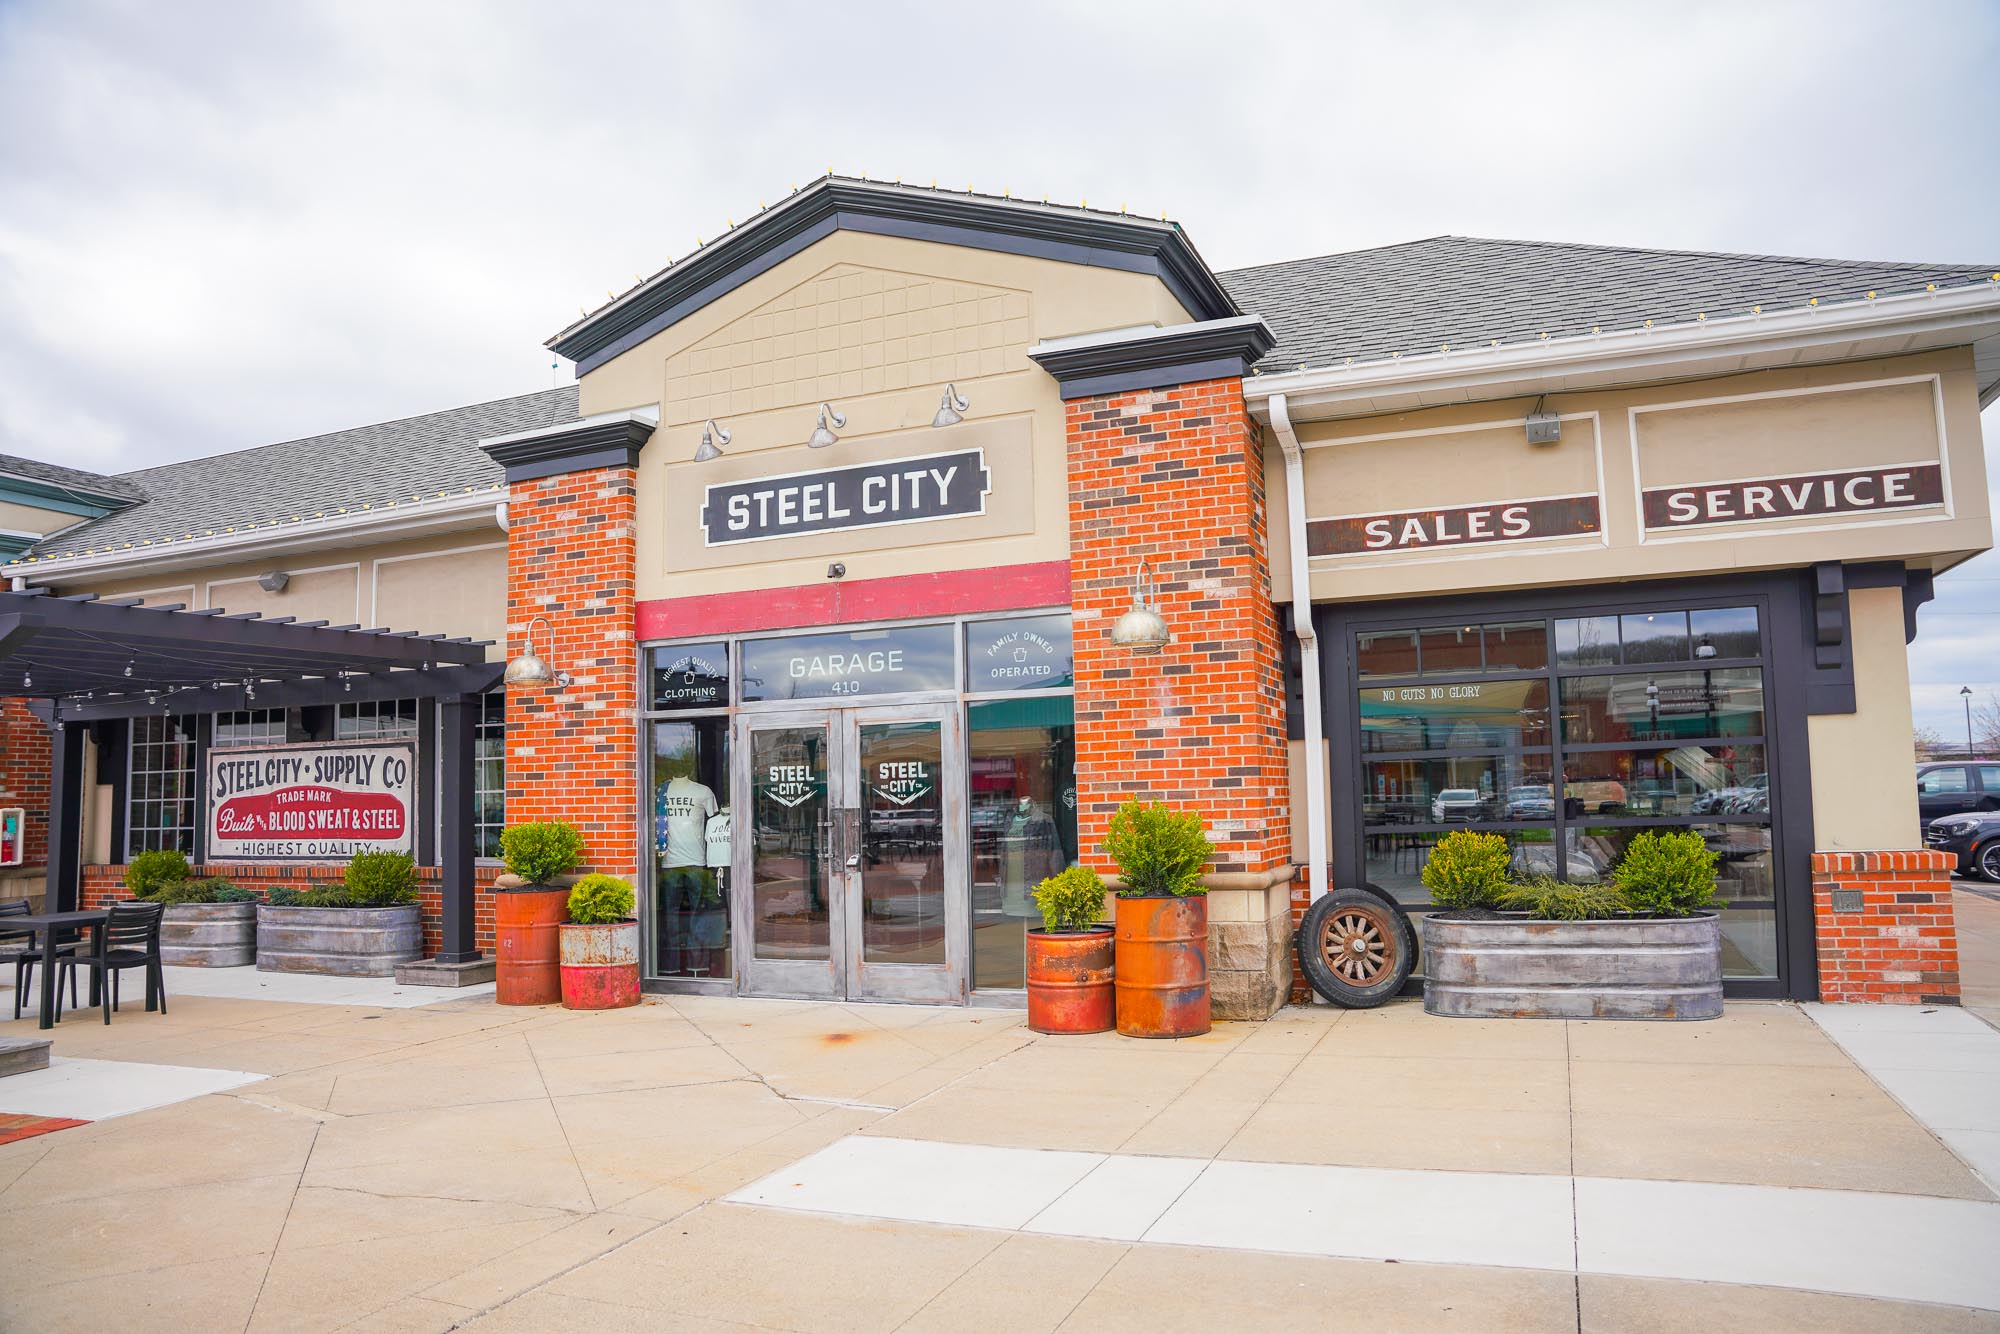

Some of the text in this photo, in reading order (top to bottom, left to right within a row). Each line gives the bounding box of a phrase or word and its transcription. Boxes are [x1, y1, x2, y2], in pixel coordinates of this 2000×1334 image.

[728, 466, 957, 531] STEEL CITY
[1667, 473, 1915, 522] SERVICE
[1364, 507, 1531, 548] SALES
[987, 632, 1054, 657] FAMILY OWNED
[662, 657, 719, 682] HIGHEST QUALITY
[790, 650, 904, 678] GARAGE
[991, 665, 1051, 678] OPERATED
[664, 687, 716, 698] CLOTHING
[832, 681, 860, 693] 410
[1383, 686, 1480, 701] NO GUTS NO GLORY
[216, 759, 265, 798] STEEL
[265, 757, 303, 786] CITY
[314, 754, 376, 786] SUPPLY
[769, 765, 815, 782] STEEL
[880, 761, 928, 779] STEEL
[779, 783, 803, 795] CITY
[889, 780, 916, 792] CITY
[276, 789, 332, 805] TRADE MARK
[218, 807, 255, 833] Built
[269, 811, 306, 831] BLOOD
[308, 808, 350, 830] SWEAT
[352, 809, 361, 830] &
[362, 809, 400, 829] STEEL
[667, 808, 692, 817] CITY
[242, 842, 372, 855] HIGHEST QUALITY
